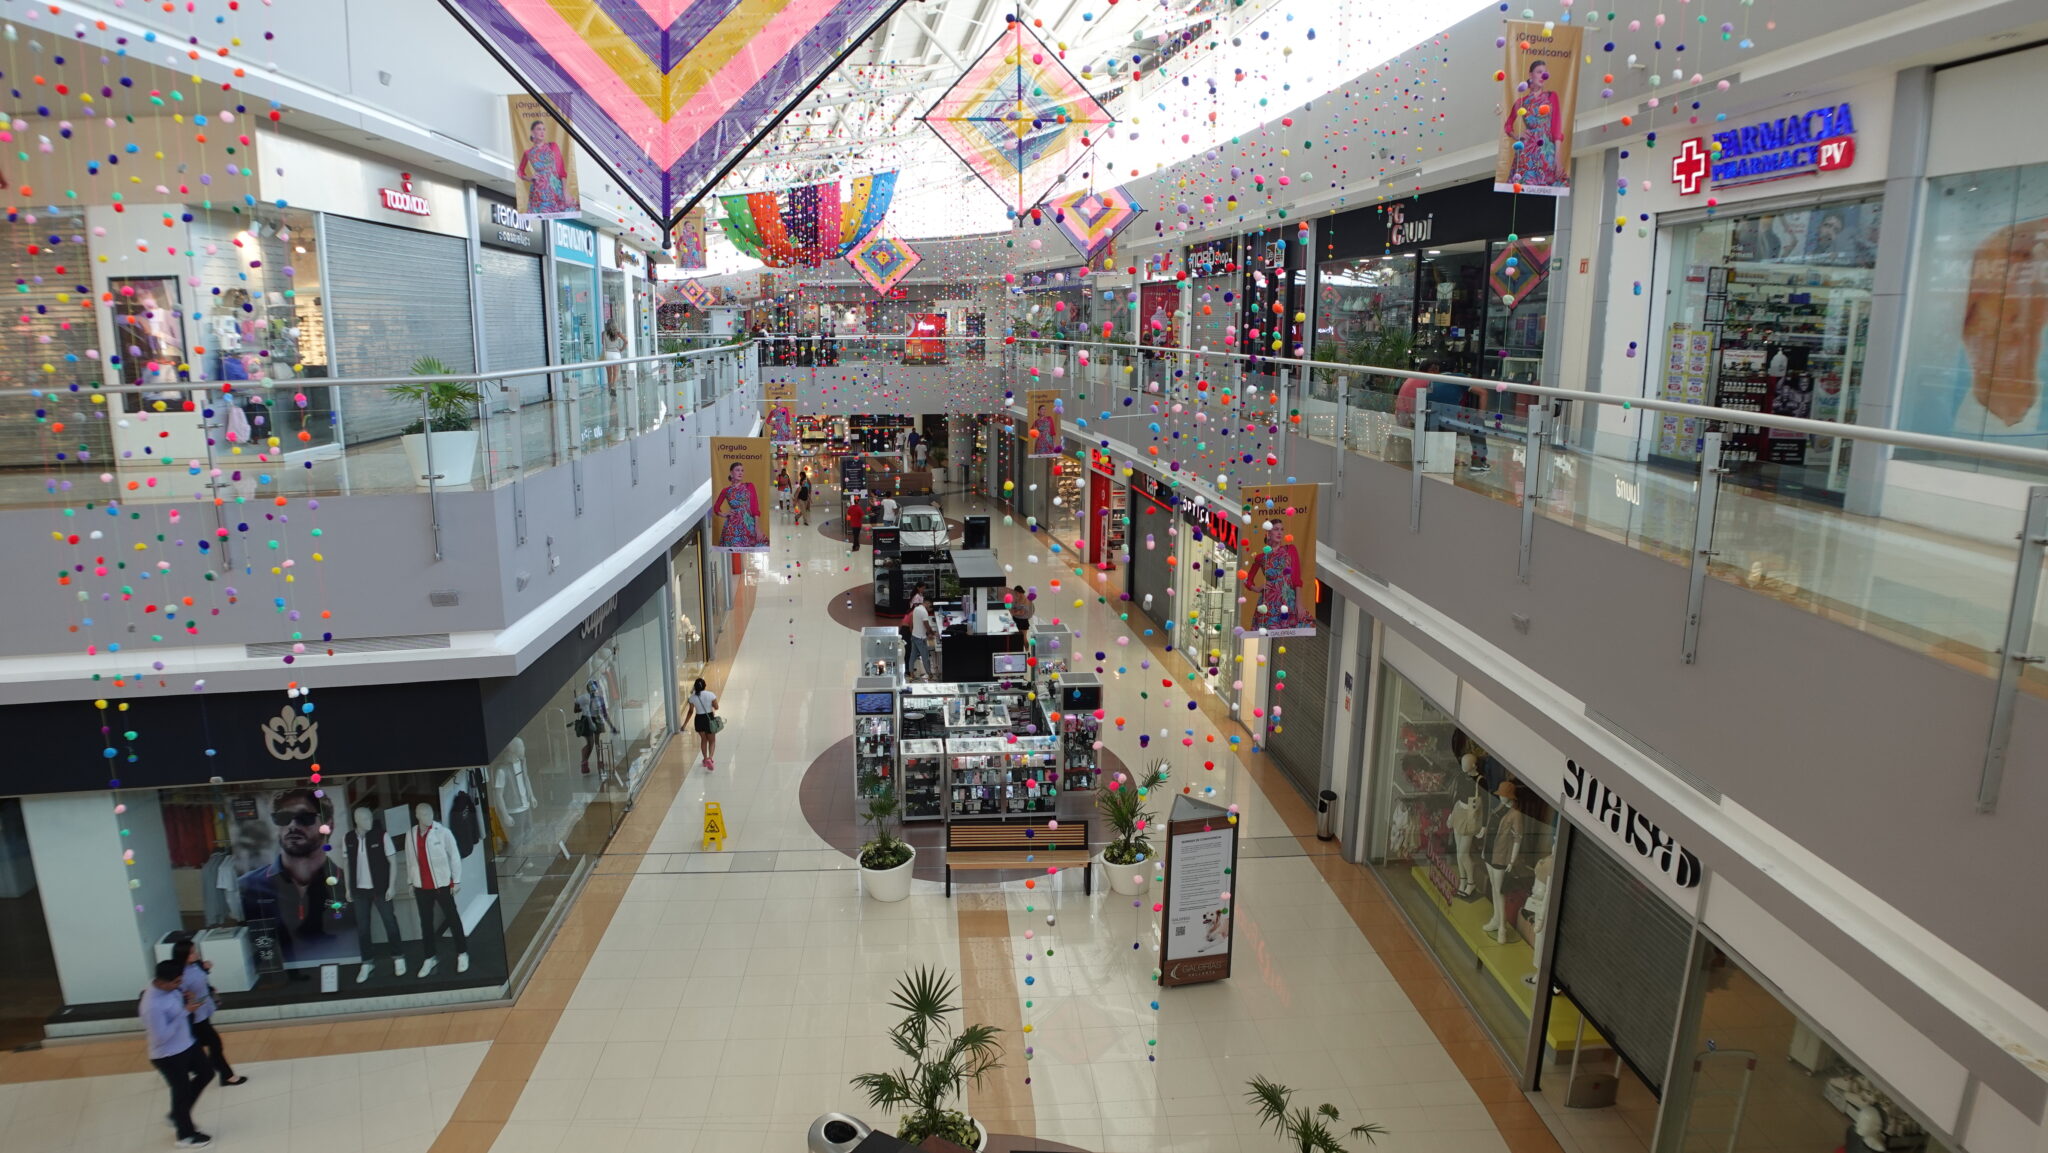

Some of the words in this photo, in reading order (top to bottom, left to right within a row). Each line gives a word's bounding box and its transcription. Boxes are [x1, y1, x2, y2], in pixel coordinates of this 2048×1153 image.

[1712, 103, 1857, 160] FARMACIA
[1711, 145, 1820, 182] PHARMACY
[1819, 141, 1847, 167] PV
[717, 443, 748, 451] ¡Orgullo
[1251, 495, 1289, 505] ¡Orullo
[1258, 505, 1308, 516] mexicno!
[1209, 511, 1238, 550] LUX
